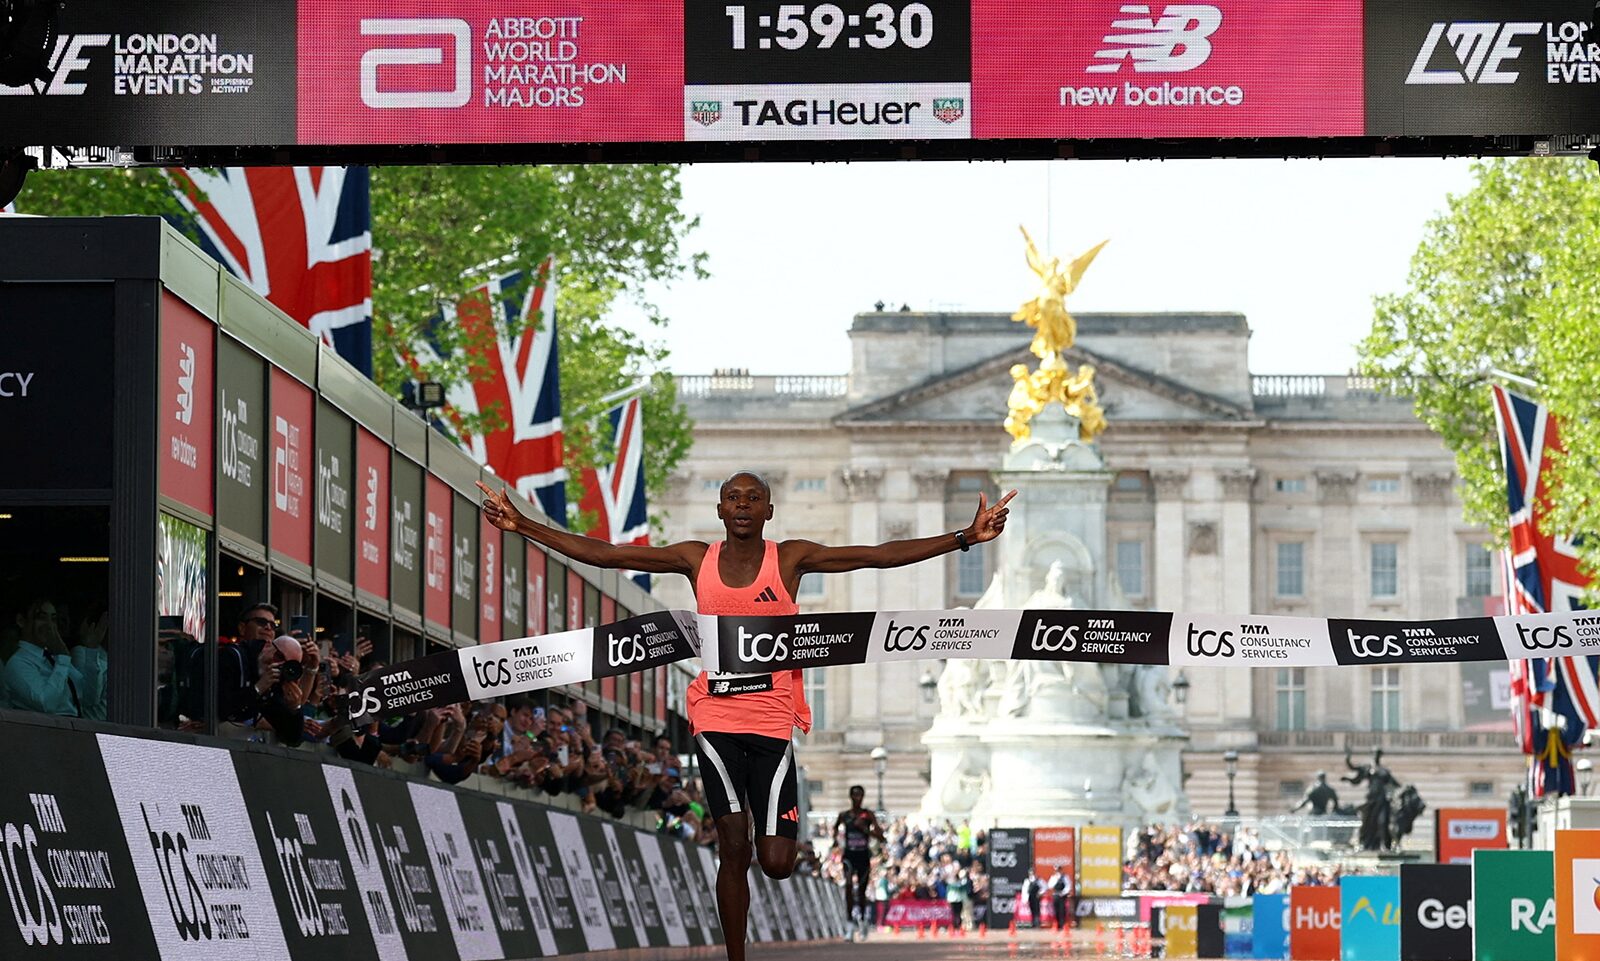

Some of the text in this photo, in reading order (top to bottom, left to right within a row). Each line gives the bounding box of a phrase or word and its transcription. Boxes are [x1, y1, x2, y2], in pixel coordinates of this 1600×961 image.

[484, 17, 585, 39] ABBOTT
[725, 2, 934, 51] 1:59:30
[114, 33, 218, 54] LONDON
[1085, 4, 1223, 74] NB
[484, 41, 578, 61] WORLD
[114, 54, 254, 74] MARATHON
[484, 63, 627, 85] MARATHON
[114, 74, 204, 95] EVENTS
[210, 78, 254, 86] INSPIRING
[484, 86, 585, 108] MAJORS
[1059, 81, 1244, 107] new balance
[640, 622, 659, 635] TATA
[794, 623, 820, 634] TATA
[938, 618, 966, 628] TATA
[1087, 619, 1115, 630] TATA
[1240, 624, 1270, 635] TATA
[1402, 627, 1435, 638] TATA
[1576, 627, 1600, 636] CON
[645, 631, 679, 646] CONSULTANCY
[738, 625, 789, 662] tcs
[792, 632, 854, 648] CONSULTANCY
[883, 619, 932, 652] tcs
[934, 628, 1000, 640] CONSULTANCY
[1031, 618, 1081, 653] tcs
[1083, 629, 1151, 643] CONSULTANCY
[1187, 622, 1236, 658] tcs
[1240, 636, 1312, 649] CONSULTANCY
[1347, 628, 1403, 658] tcs
[1405, 635, 1480, 648] CONSULTANCY
[1516, 622, 1573, 650] tcs
[512, 645, 540, 658] TATA
[608, 632, 646, 668] tcs
[648, 643, 675, 659] SERVICES
[791, 646, 831, 661] SERVICES
[930, 639, 973, 651] SERVICES
[1080, 641, 1126, 654] SERVICES
[1241, 648, 1288, 660] SERVICES
[1409, 645, 1458, 657] SERVICES
[513, 652, 576, 671] CONSULTANCY
[380, 670, 412, 686] TATA
[472, 655, 512, 690] tcs
[515, 667, 553, 683] SERVICES
[383, 672, 452, 698] CONSULTANCY
[742, 682, 767, 691] balance
[386, 689, 434, 710] SERVICES
[28, 793, 67, 833] TATA
[180, 803, 212, 840] TATA
[47, 848, 116, 889] CONSULTANCY
[140, 801, 212, 941] tcs
[196, 853, 252, 890] CONSULTANCY
[266, 810, 325, 938] tcs
[62, 904, 111, 945] SERVICES
[210, 904, 250, 940] SERVICES
[1295, 906, 1341, 929] Hub
